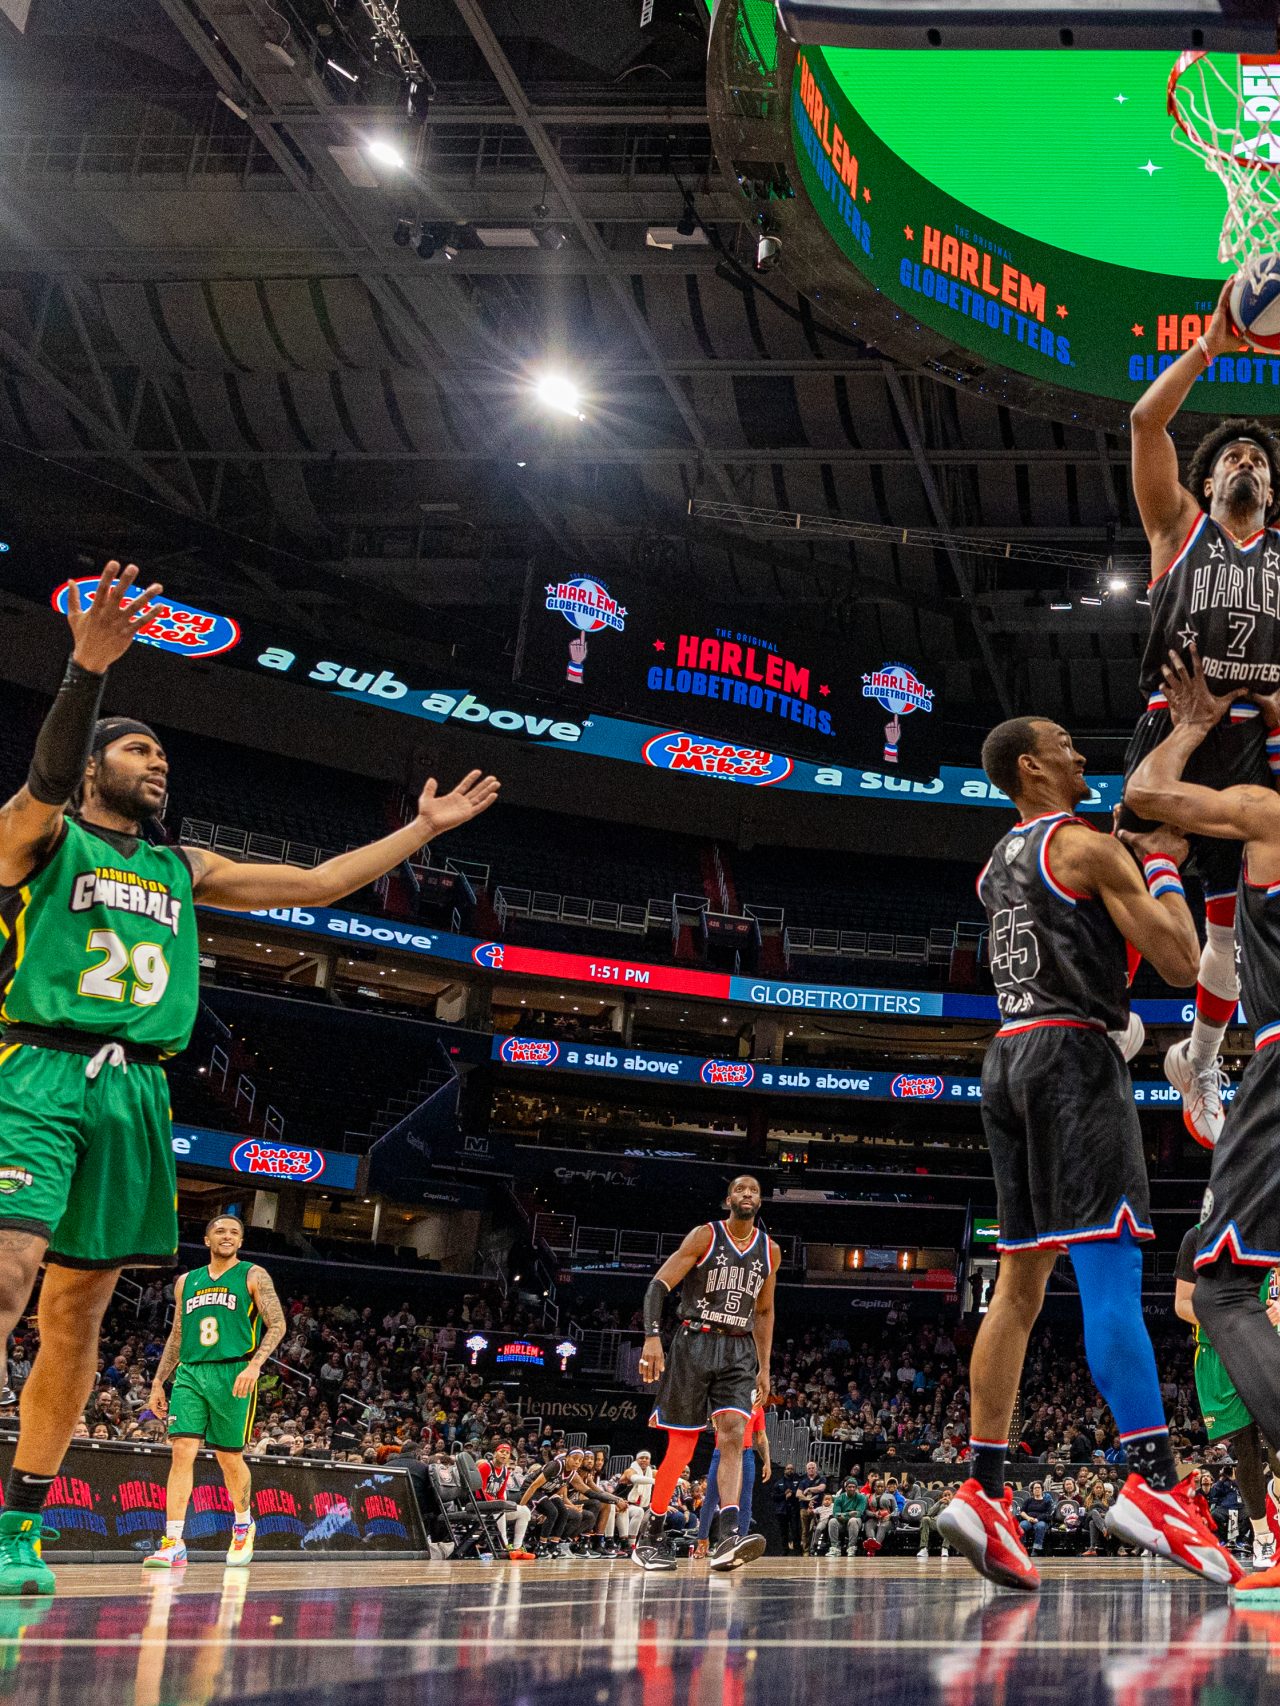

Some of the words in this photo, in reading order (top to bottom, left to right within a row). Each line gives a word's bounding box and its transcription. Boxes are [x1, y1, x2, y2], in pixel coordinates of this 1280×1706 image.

[801, 56, 859, 200] HARLEM
[922, 225, 1046, 323] HARLEM
[900, 258, 1071, 365] GLOBETROTTERS
[558, 584, 616, 614] HARLEM
[547, 598, 623, 630] GLOBETROTTERS
[716, 628, 732, 638] THE
[736, 632, 779, 653] ORIGINAL
[1227, 612, 1256, 658] 7
[257, 646, 294, 672] a
[308, 659, 409, 700] sub
[676, 634, 810, 700] HARLEM
[872, 673, 924, 697] HARLEM
[864, 686, 931, 711] GLOBETROTTERS
[665, 738, 772, 766] Jersey
[669, 752, 771, 776] Mike's
[815, 768, 843, 787] a
[78, 929, 170, 1007] 29
[589, 964, 619, 980] 1:51
[625, 968, 650, 984] PM
[750, 984, 921, 1014] GLOBETROTTERS
[997, 992, 1034, 1013] CRASH
[508, 1040, 551, 1053] Jersey
[567, 1051, 578, 1063] a
[585, 1052, 618, 1067] sub
[709, 1062, 747, 1074] Jersey
[762, 1072, 772, 1084] a
[778, 1072, 810, 1087] sub
[898, 1076, 937, 1089] Jersey
[951, 1085, 961, 1095] a
[967, 1085, 983, 1096] su
[1134, 1089, 1144, 1100] a
[1150, 1087, 1181, 1101] sub
[245, 1144, 312, 1163] Jersey
[250, 1158, 312, 1174] Mike's
[186, 1292, 236, 1314] GENERALS
[725, 1291, 742, 1313] 5
[200, 1316, 219, 1346] 8
[504, 1344, 539, 1357] HARLEM
[600, 1400, 638, 1421] Lofts
[255, 1488, 297, 1517] HARLEM
[364, 1495, 398, 1520] HARLEM
